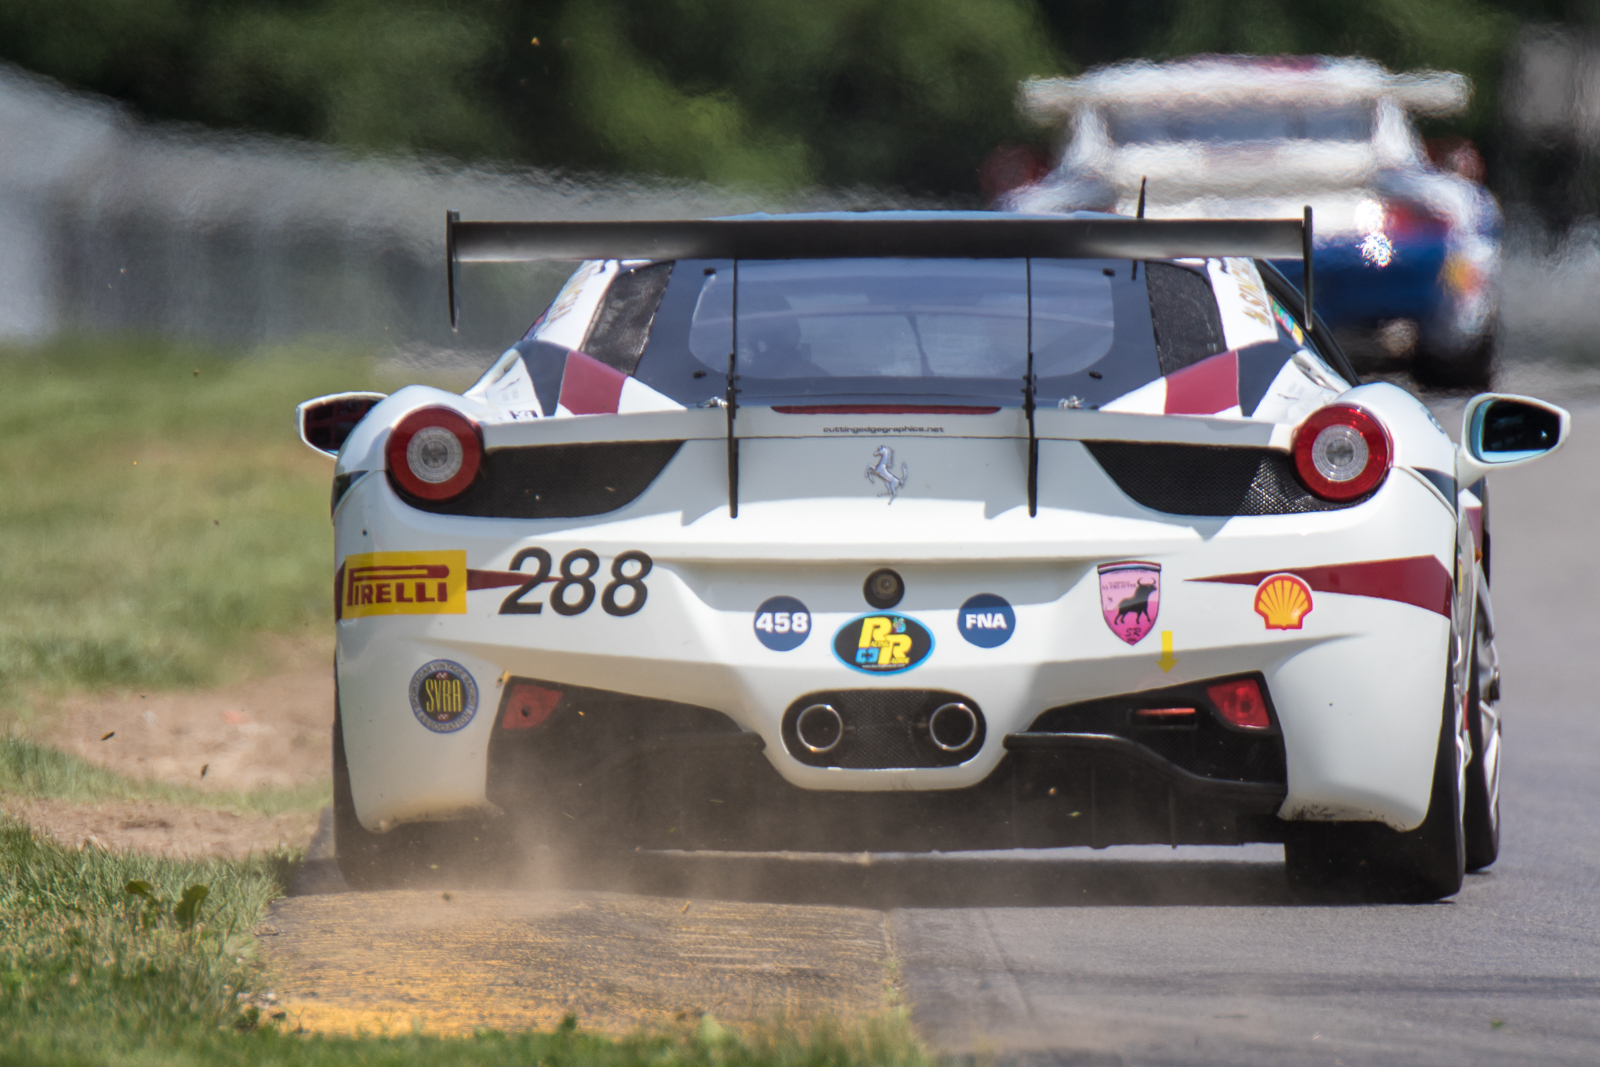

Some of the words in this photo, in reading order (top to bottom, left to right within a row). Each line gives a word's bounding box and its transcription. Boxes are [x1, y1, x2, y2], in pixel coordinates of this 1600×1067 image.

[346, 564, 450, 607] PIRELLI
[498, 546, 653, 617] 288
[755, 612, 809, 633] 458
[965, 613, 1007, 629] FNA
[432, 662, 464, 677] VINTAGE
[425, 678, 462, 713] SVRA
